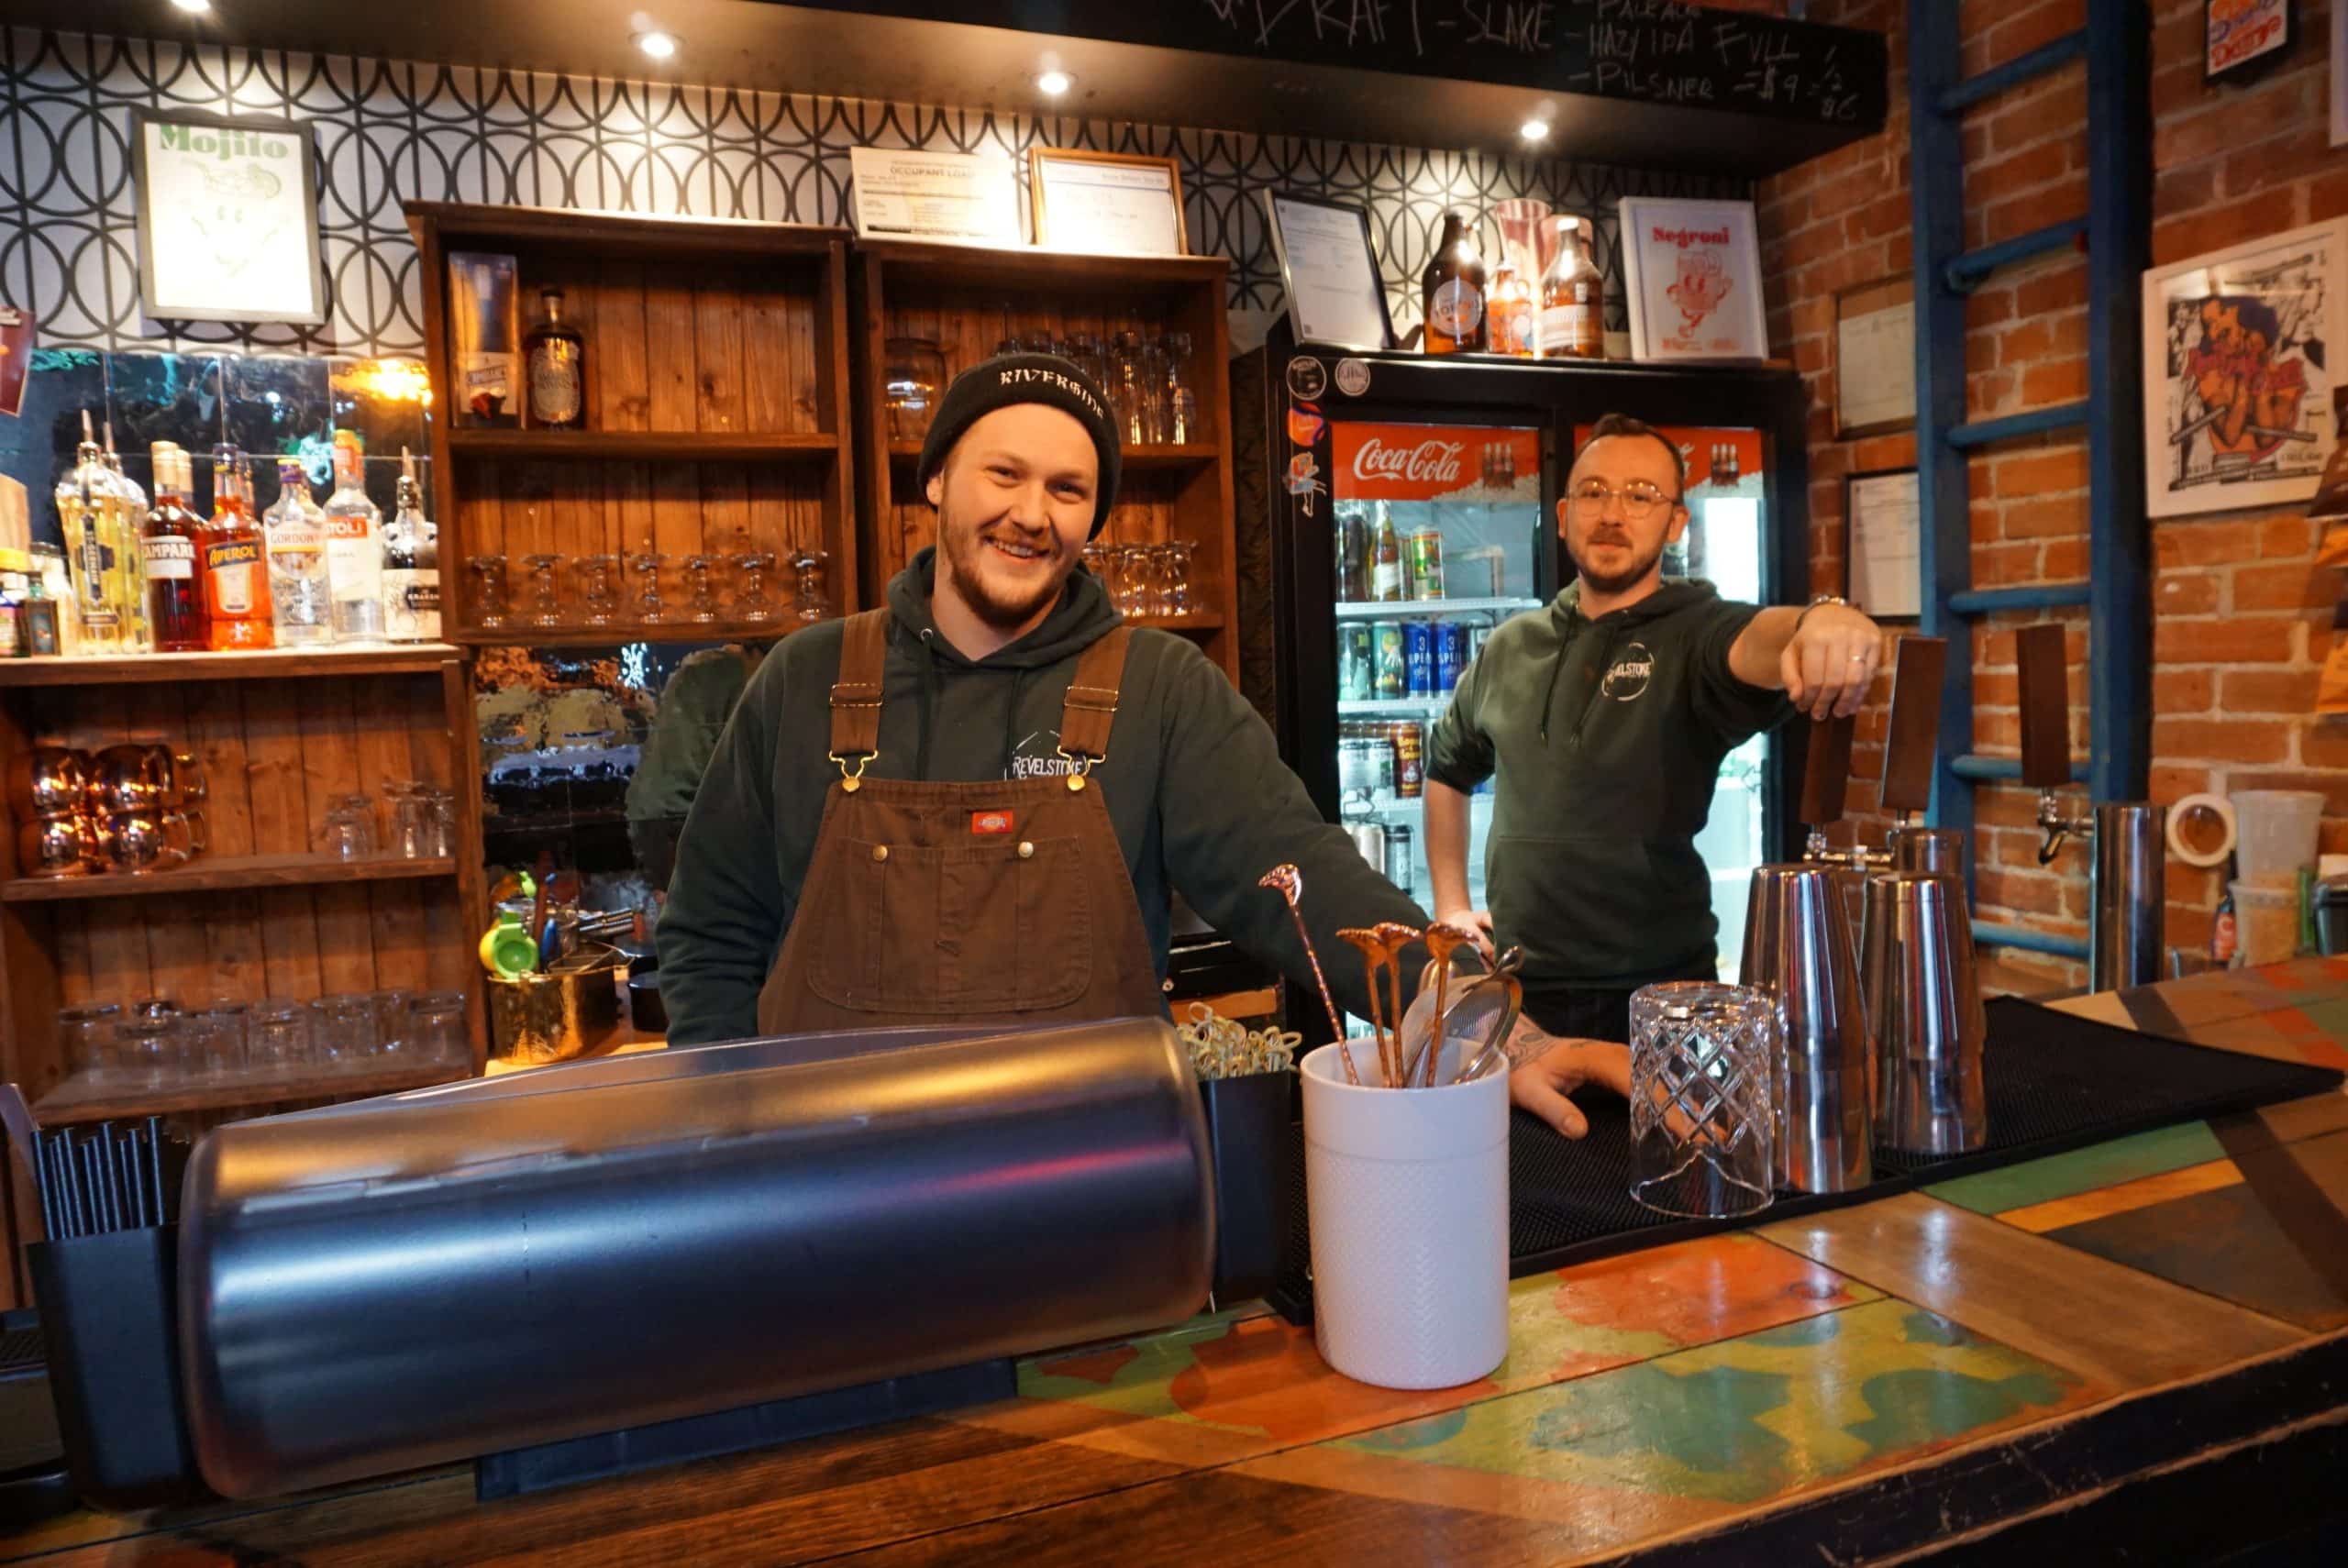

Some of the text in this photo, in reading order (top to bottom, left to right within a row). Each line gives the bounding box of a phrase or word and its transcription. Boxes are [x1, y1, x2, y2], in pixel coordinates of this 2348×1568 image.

[1589, 21, 1695, 64] HAZY IPA
[1596, 61, 1715, 101] PILSNER
[160, 124, 288, 160] Mojito
[1652, 226, 1730, 248] Negroni
[1000, 369, 1104, 418] RIVERSIDE
[143, 543, 195, 558] AMPARI
[209, 546, 257, 565] APEROL
